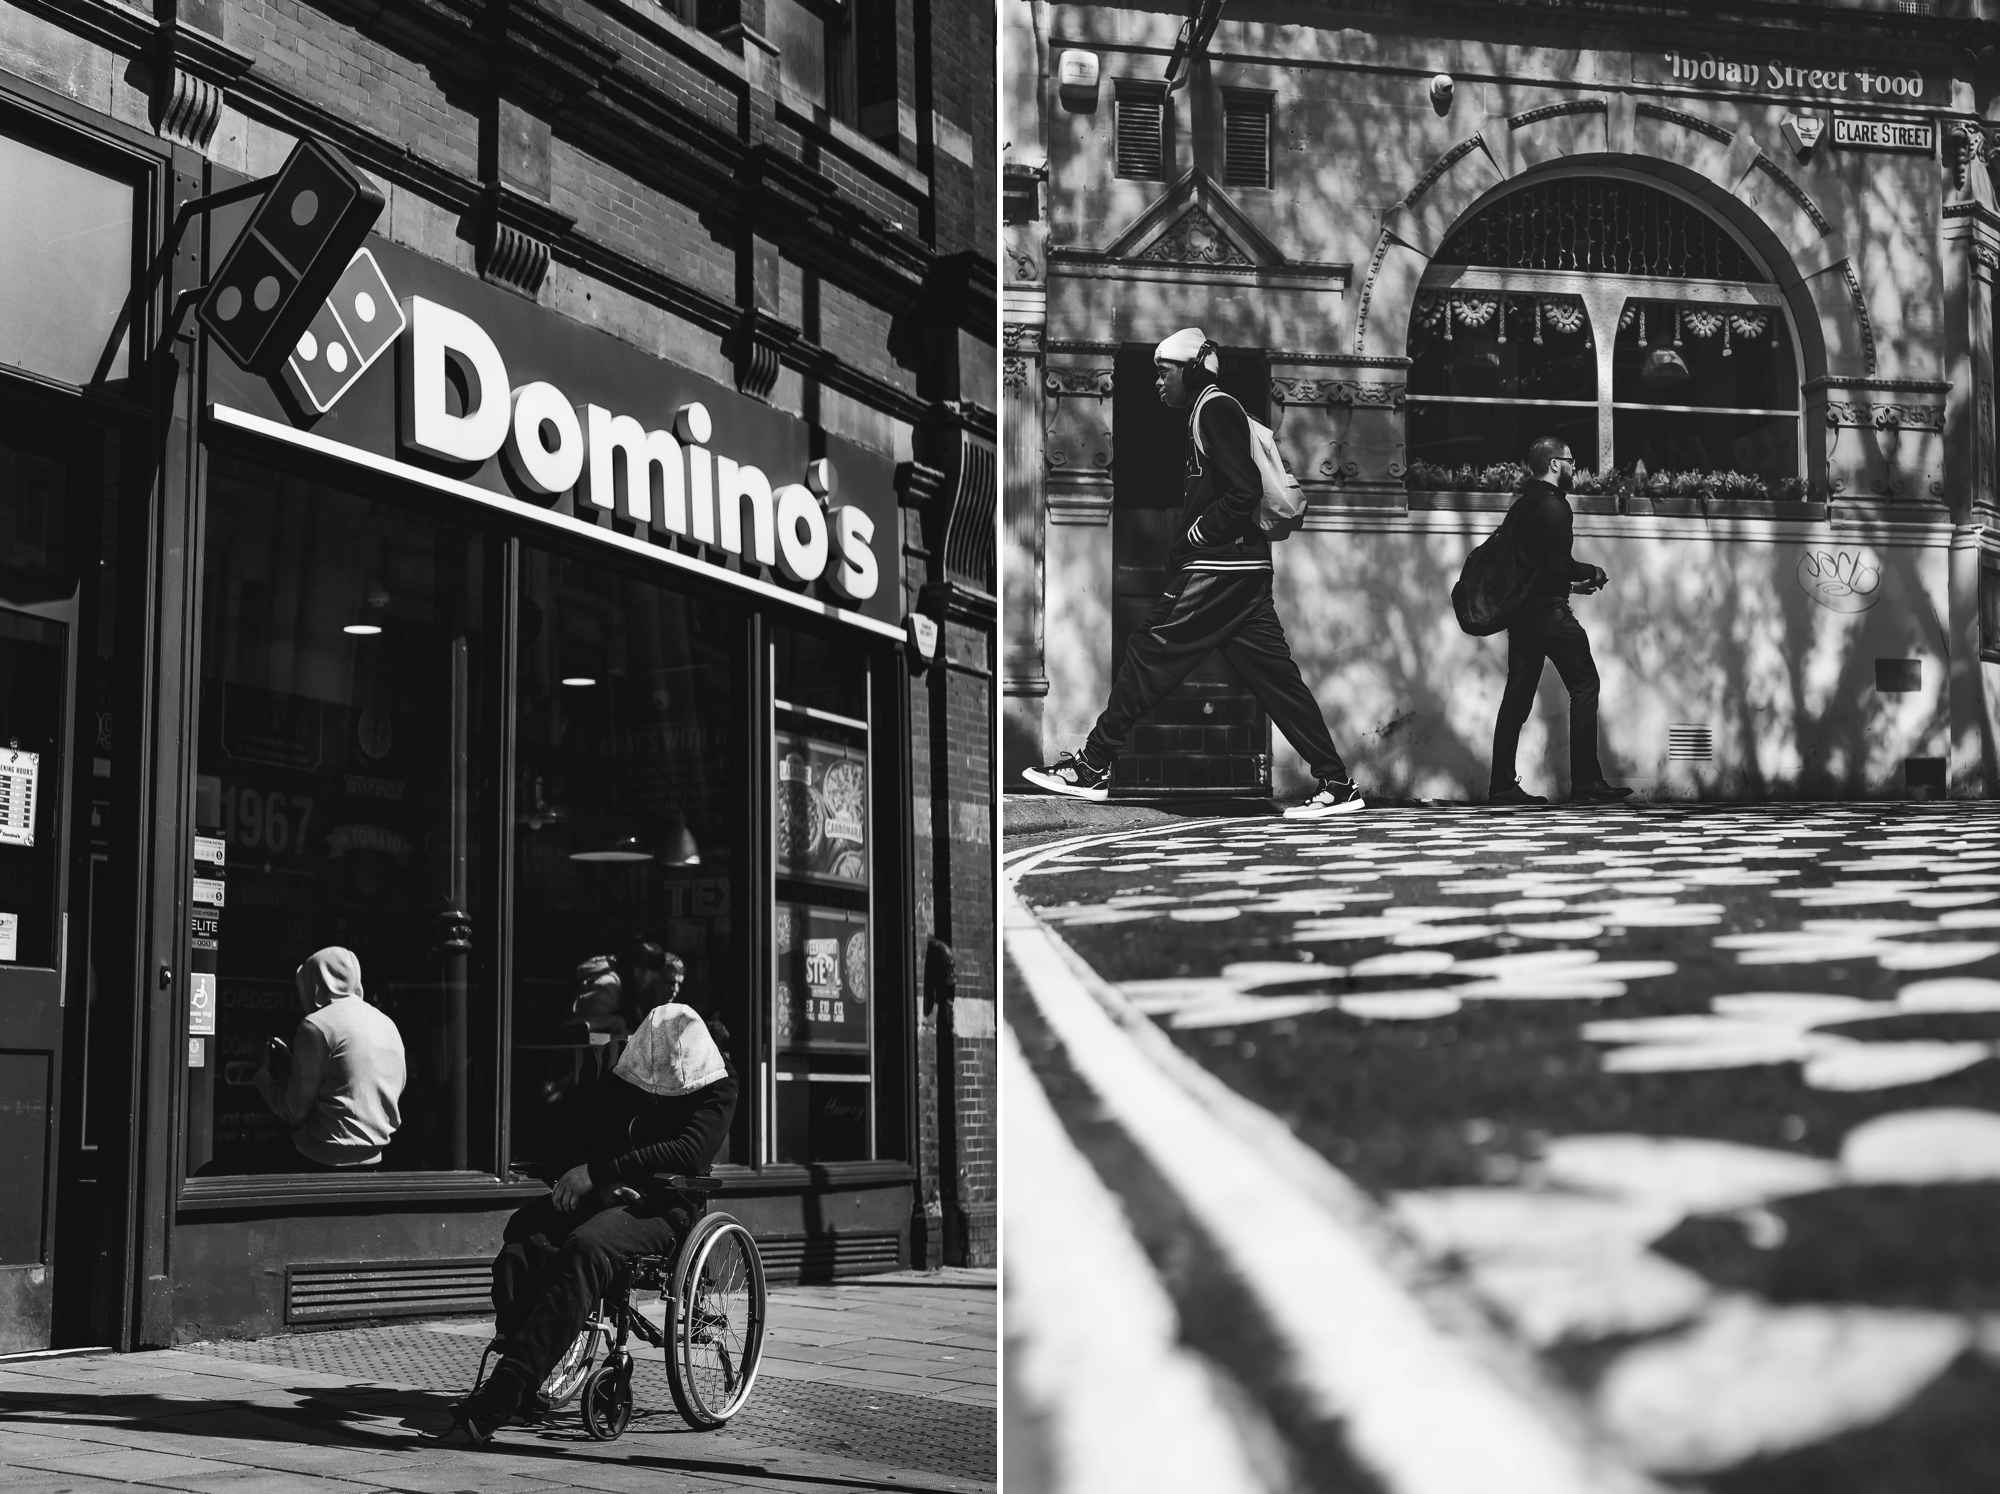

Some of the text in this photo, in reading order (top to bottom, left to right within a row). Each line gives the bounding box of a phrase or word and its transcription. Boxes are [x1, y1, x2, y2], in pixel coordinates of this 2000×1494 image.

[1664, 50, 1924, 98] Indian Street Food
[1836, 120, 1930, 147] CLARE STREET
[406, 294, 880, 602] Domino's
[191, 919, 218, 933] ELITE
